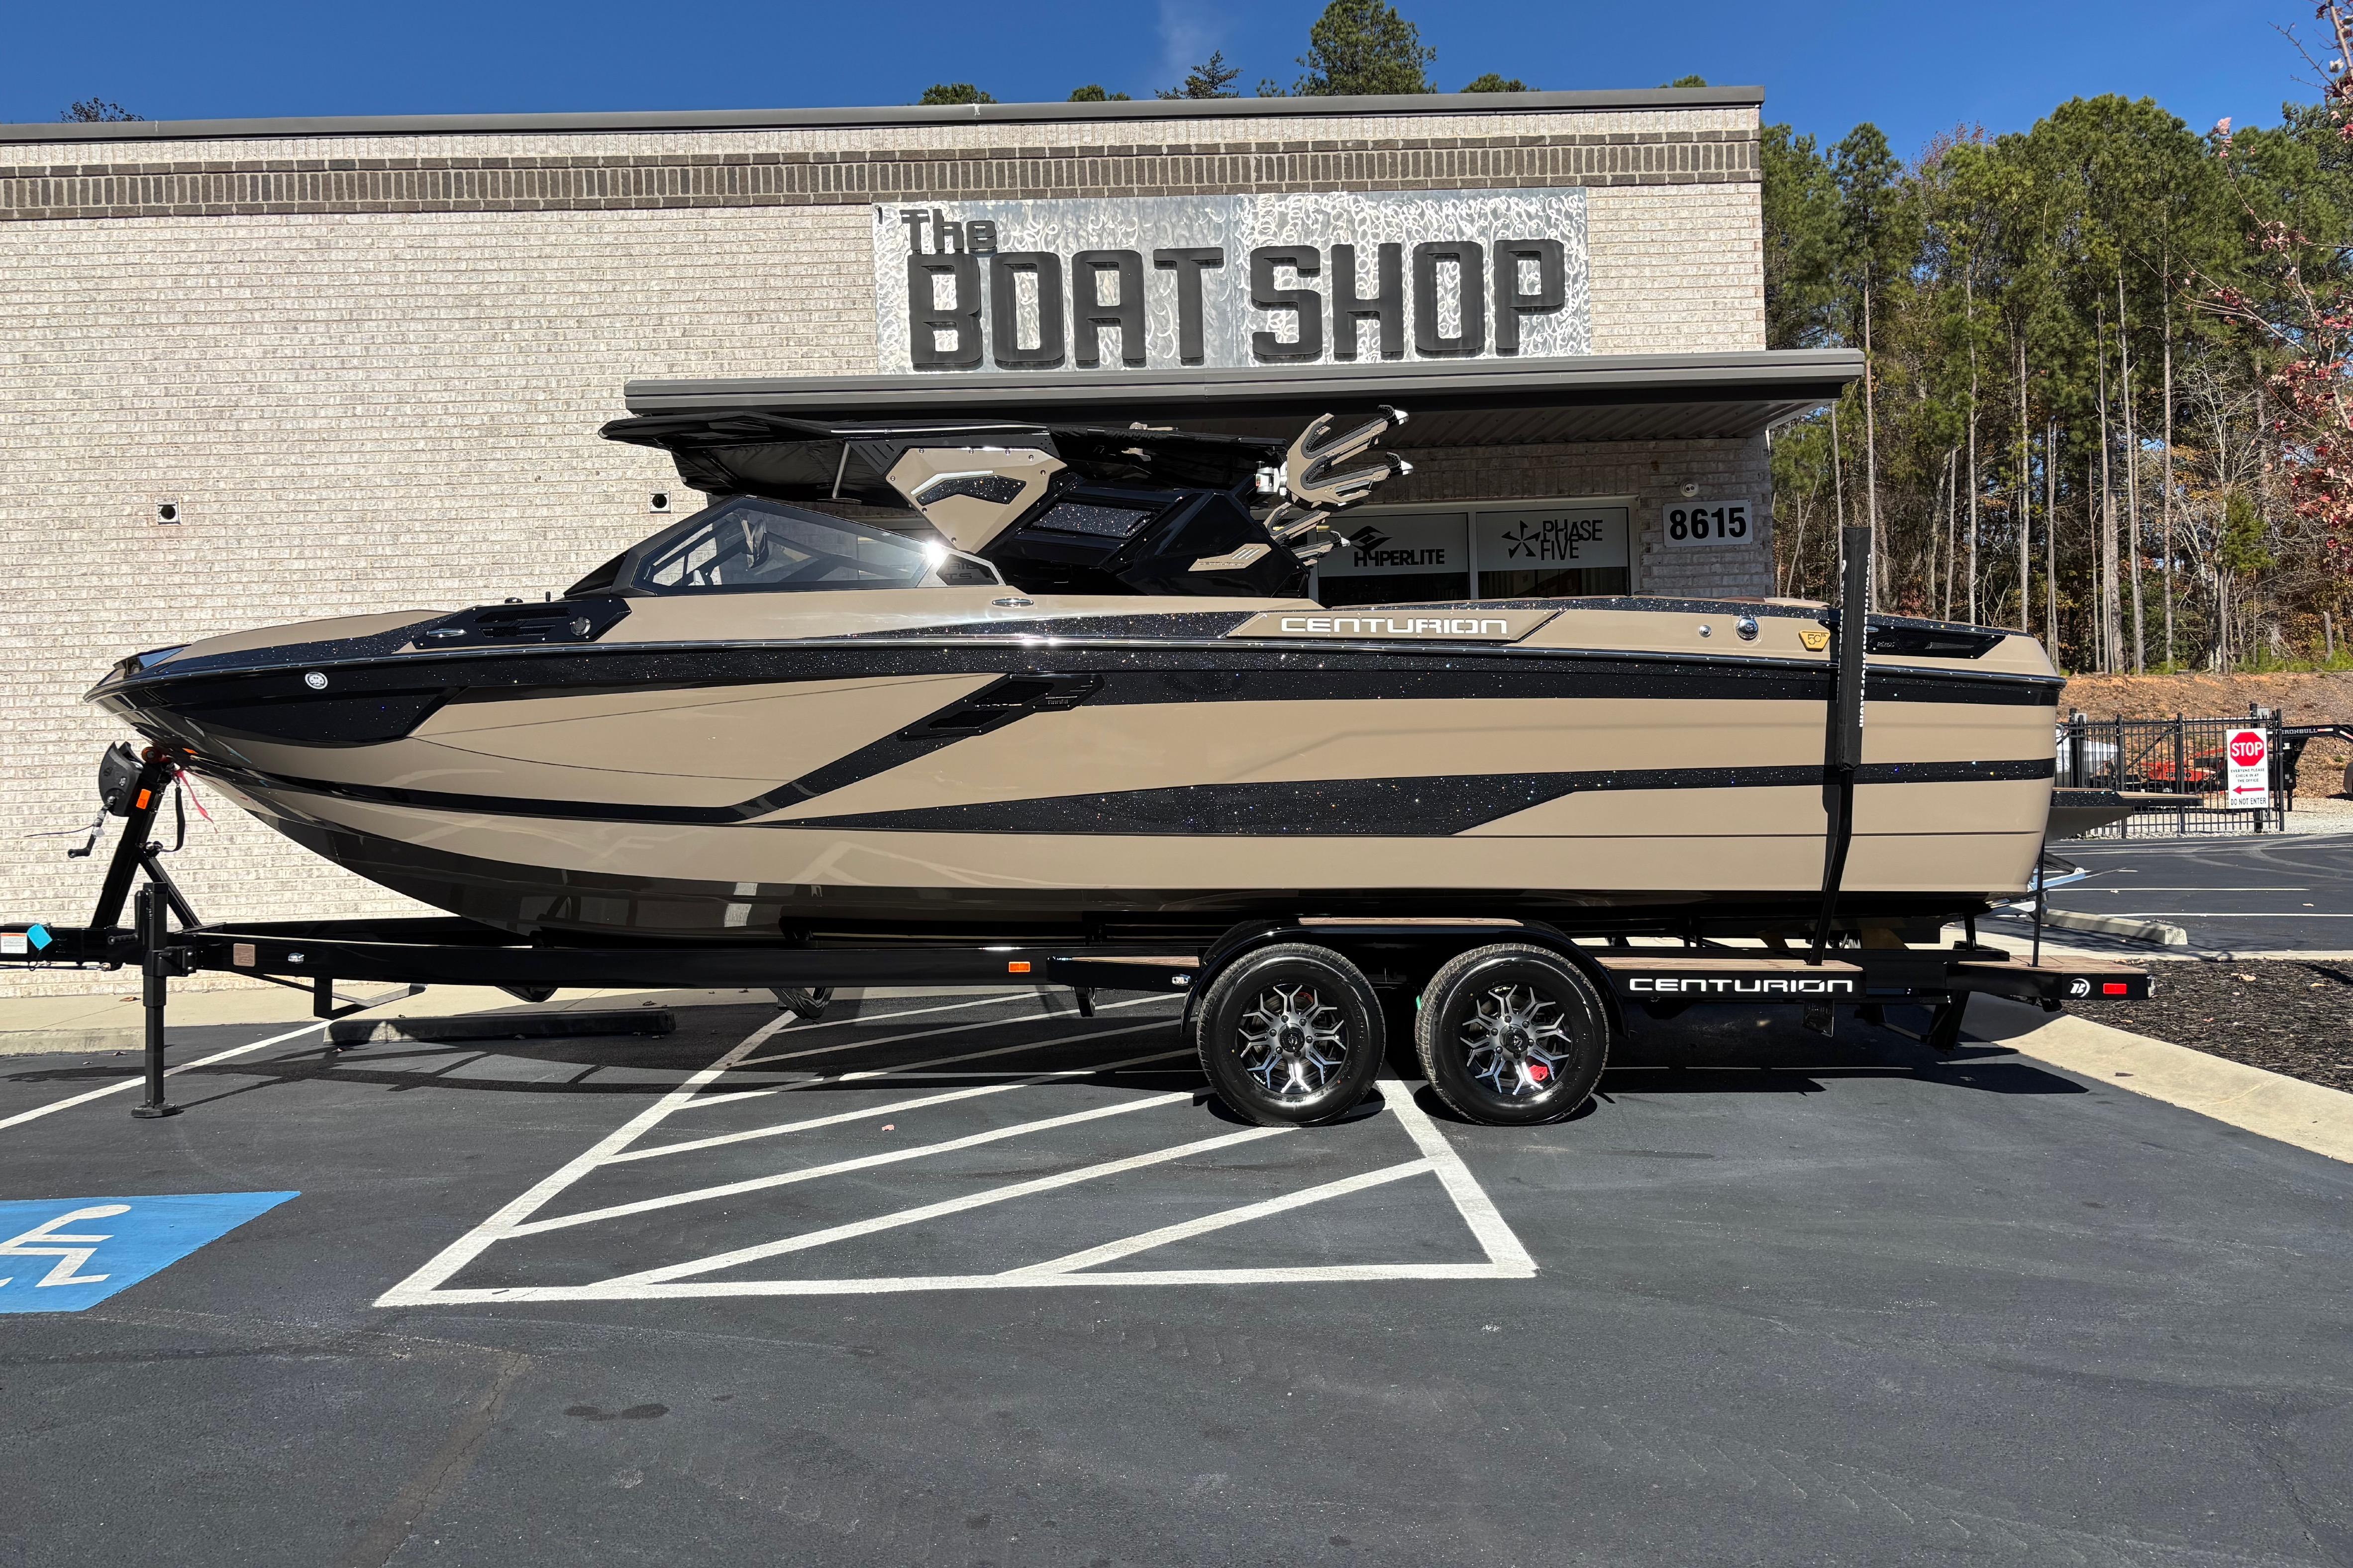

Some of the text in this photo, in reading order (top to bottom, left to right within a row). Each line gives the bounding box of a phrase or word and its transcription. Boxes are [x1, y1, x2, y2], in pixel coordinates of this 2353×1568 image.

[900, 208, 997, 252] The
[907, 239, 1565, 371] BOAT SHOP
[1542, 519, 1603, 541] PHASE
[1669, 507, 1746, 540] 8615
[1353, 549, 1445, 567] HYPERLITE
[1540, 539, 1579, 561] FIVE
[1281, 616, 1507, 634] CENTURION
[1808, 633, 1826, 645] 50th
[2231, 741, 2263, 757] STOP
[1630, 978, 1853, 992] CENTURION
